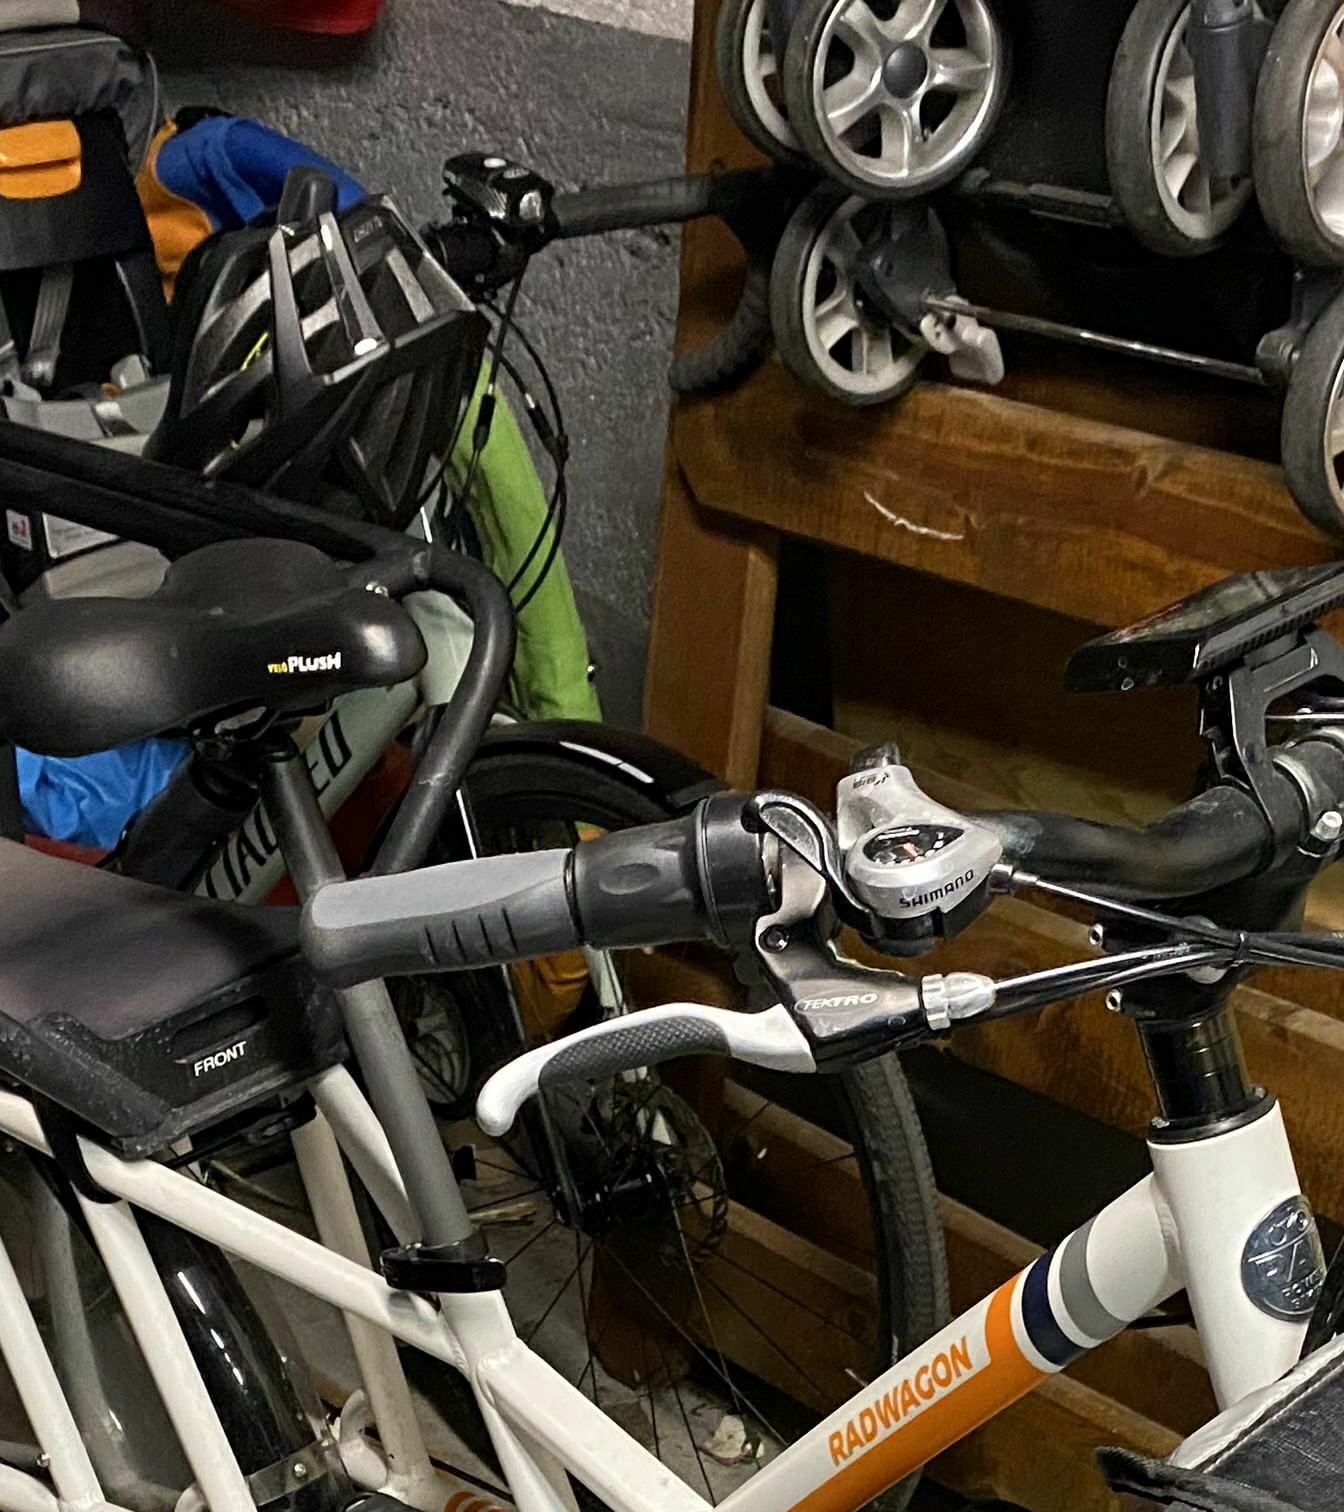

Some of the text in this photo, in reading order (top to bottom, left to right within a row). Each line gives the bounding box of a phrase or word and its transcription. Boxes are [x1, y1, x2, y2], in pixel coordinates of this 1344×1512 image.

[287, 651, 342, 674] PLUSH
[899, 868, 975, 909] SHIMANO
[803, 993, 878, 1011] TEKTRO
[194, 1040, 247, 1077] FRONT
[828, 1336, 973, 1467] RADWAGON
